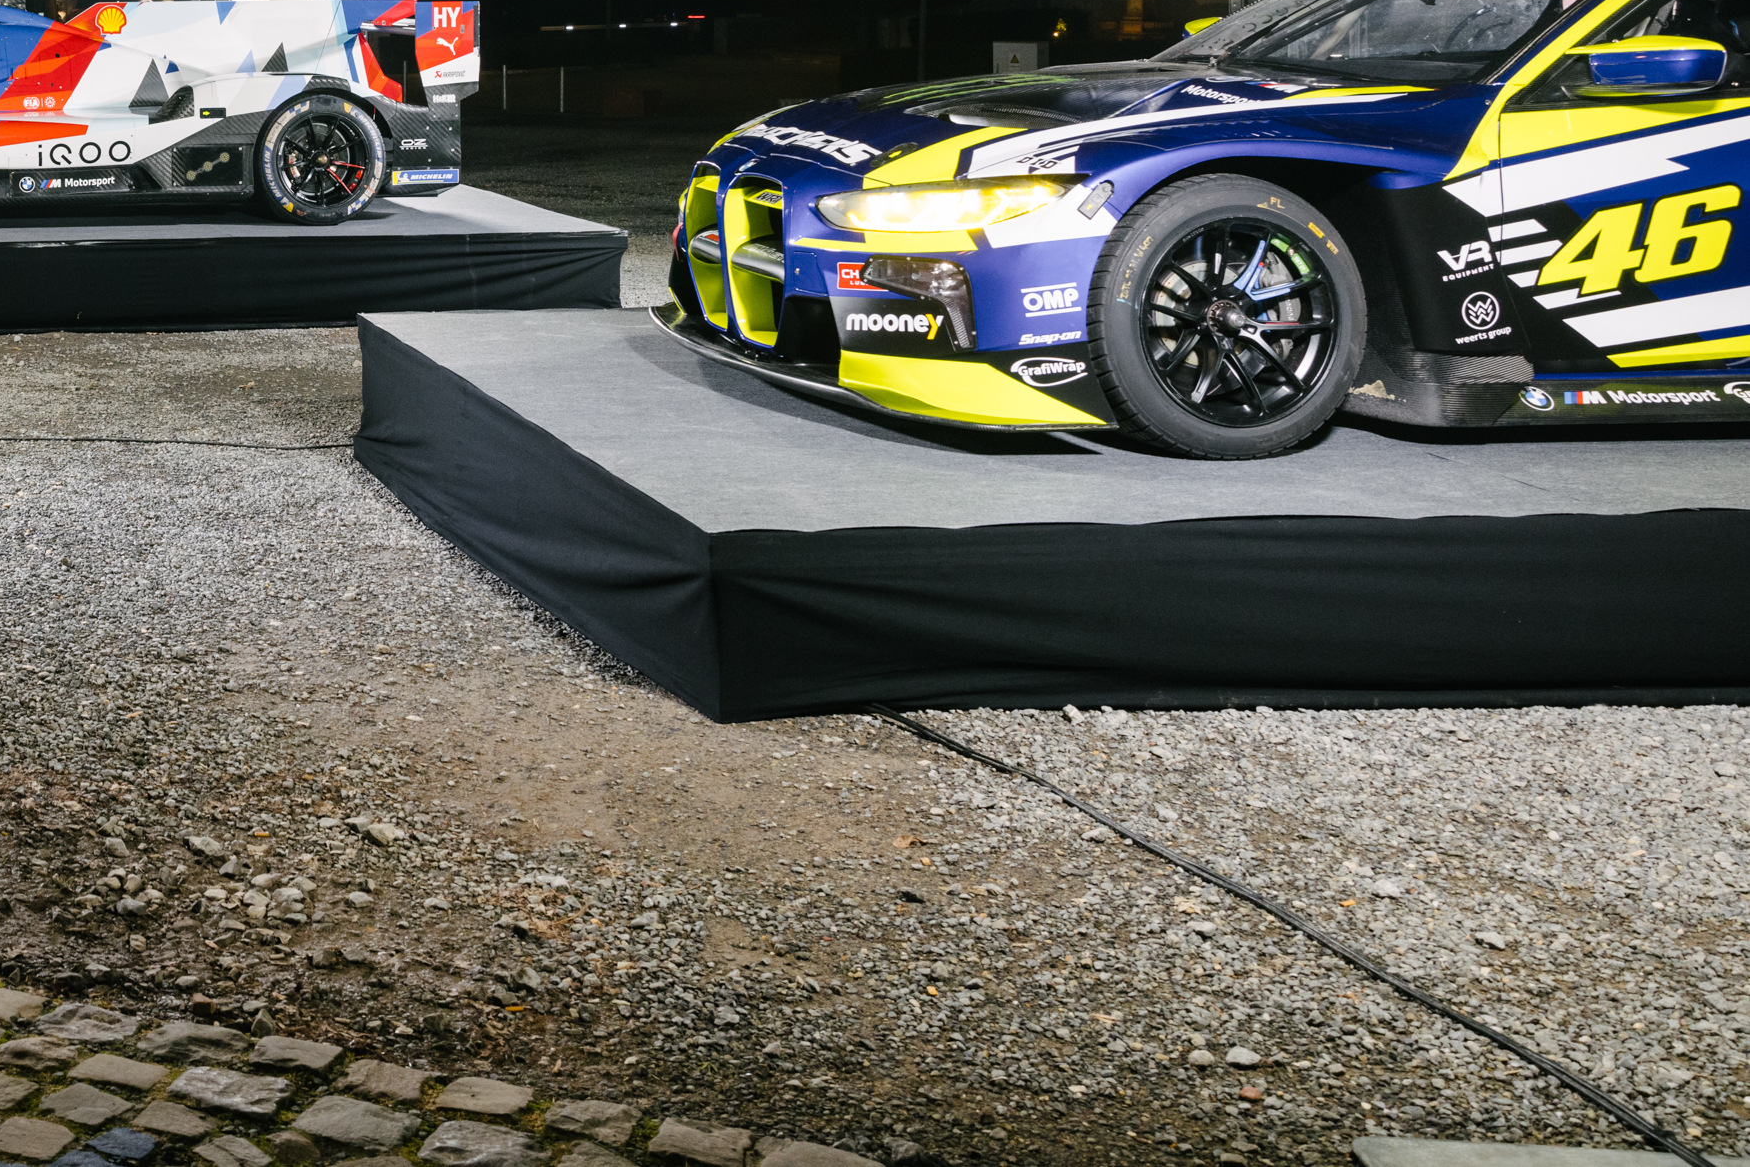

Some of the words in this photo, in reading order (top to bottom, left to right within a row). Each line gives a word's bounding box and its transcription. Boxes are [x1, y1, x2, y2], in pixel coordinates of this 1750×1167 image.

[433, 7, 461, 28] HY
[24, 99, 39, 107] FIA
[358, 114, 383, 159] MICHELIN
[38, 140, 132, 167] iQOO
[64, 176, 116, 187] Motorsport
[264, 150, 282, 199] MICHELIN
[1537, 184, 1742, 295] 46
[1442, 263, 1495, 282] EQUIPMENT
[1022, 287, 1079, 312] OMP
[846, 313, 944, 340] mooney
[1455, 332, 1488, 345] weerts
[1488, 326, 1512, 340] group
[1018, 331, 1082, 345] Snap-on
[1017, 361, 1086, 377] GrafiWrap
[1606, 389, 1722, 405] Motorsport
